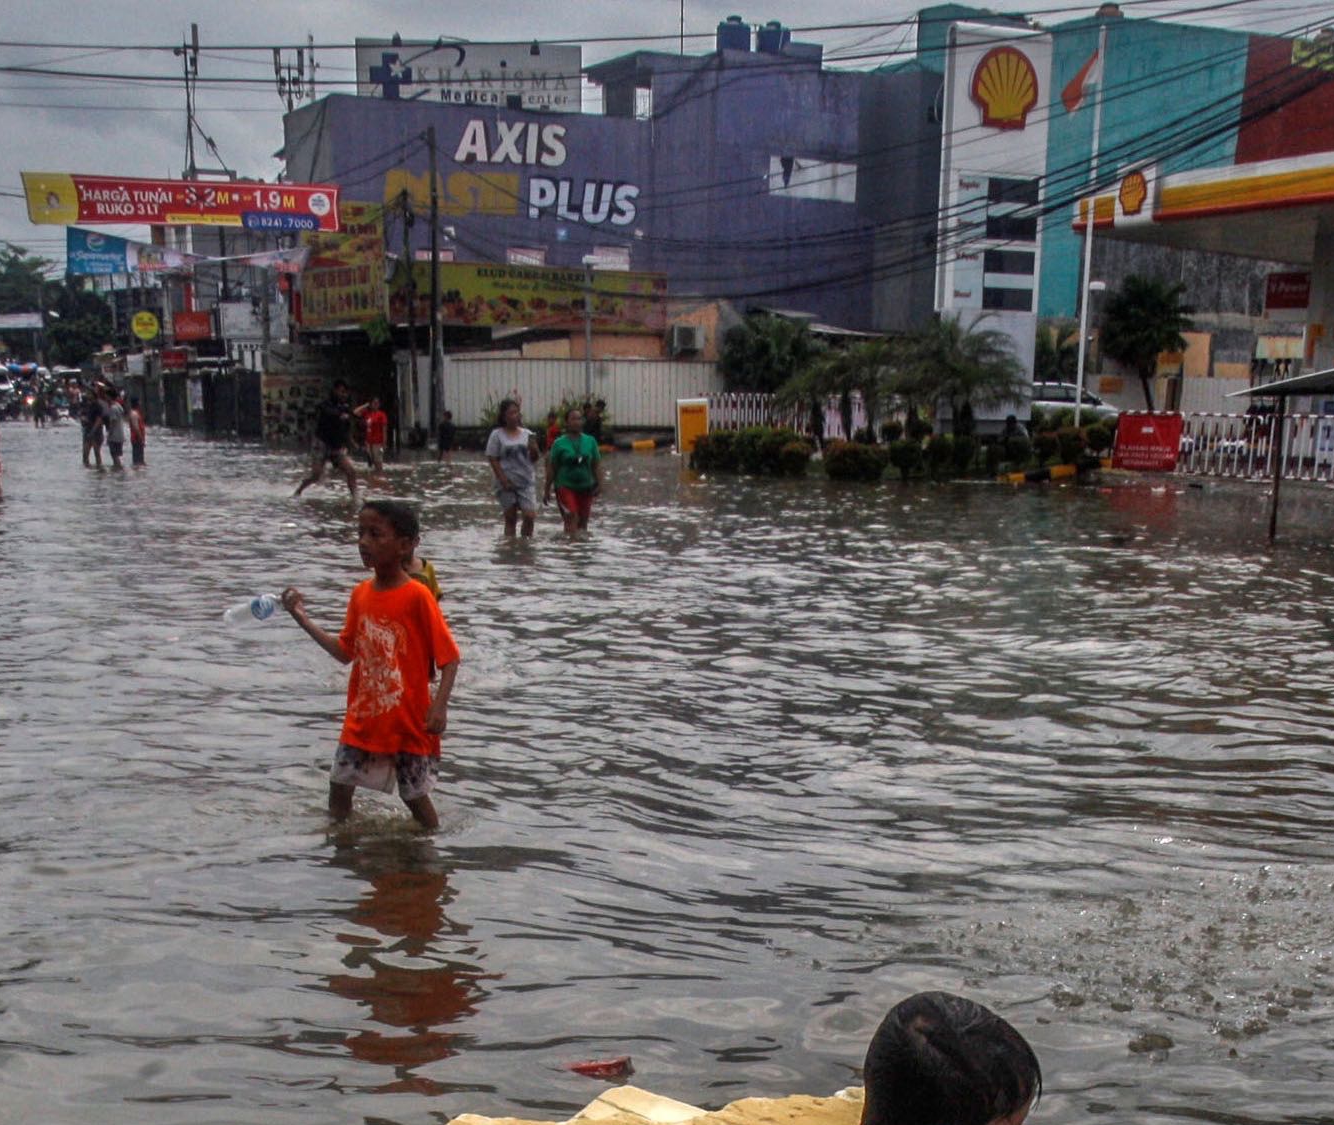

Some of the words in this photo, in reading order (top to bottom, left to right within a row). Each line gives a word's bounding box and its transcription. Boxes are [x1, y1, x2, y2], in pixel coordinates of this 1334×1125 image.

[417, 60, 567, 91] KHARISMA
[454, 119, 567, 166] AXIS
[82, 189, 130, 202] HARGA
[132, 190, 173, 204] TUNAI
[97, 202, 135, 215] RUKO
[528, 178, 640, 225] PLUS
